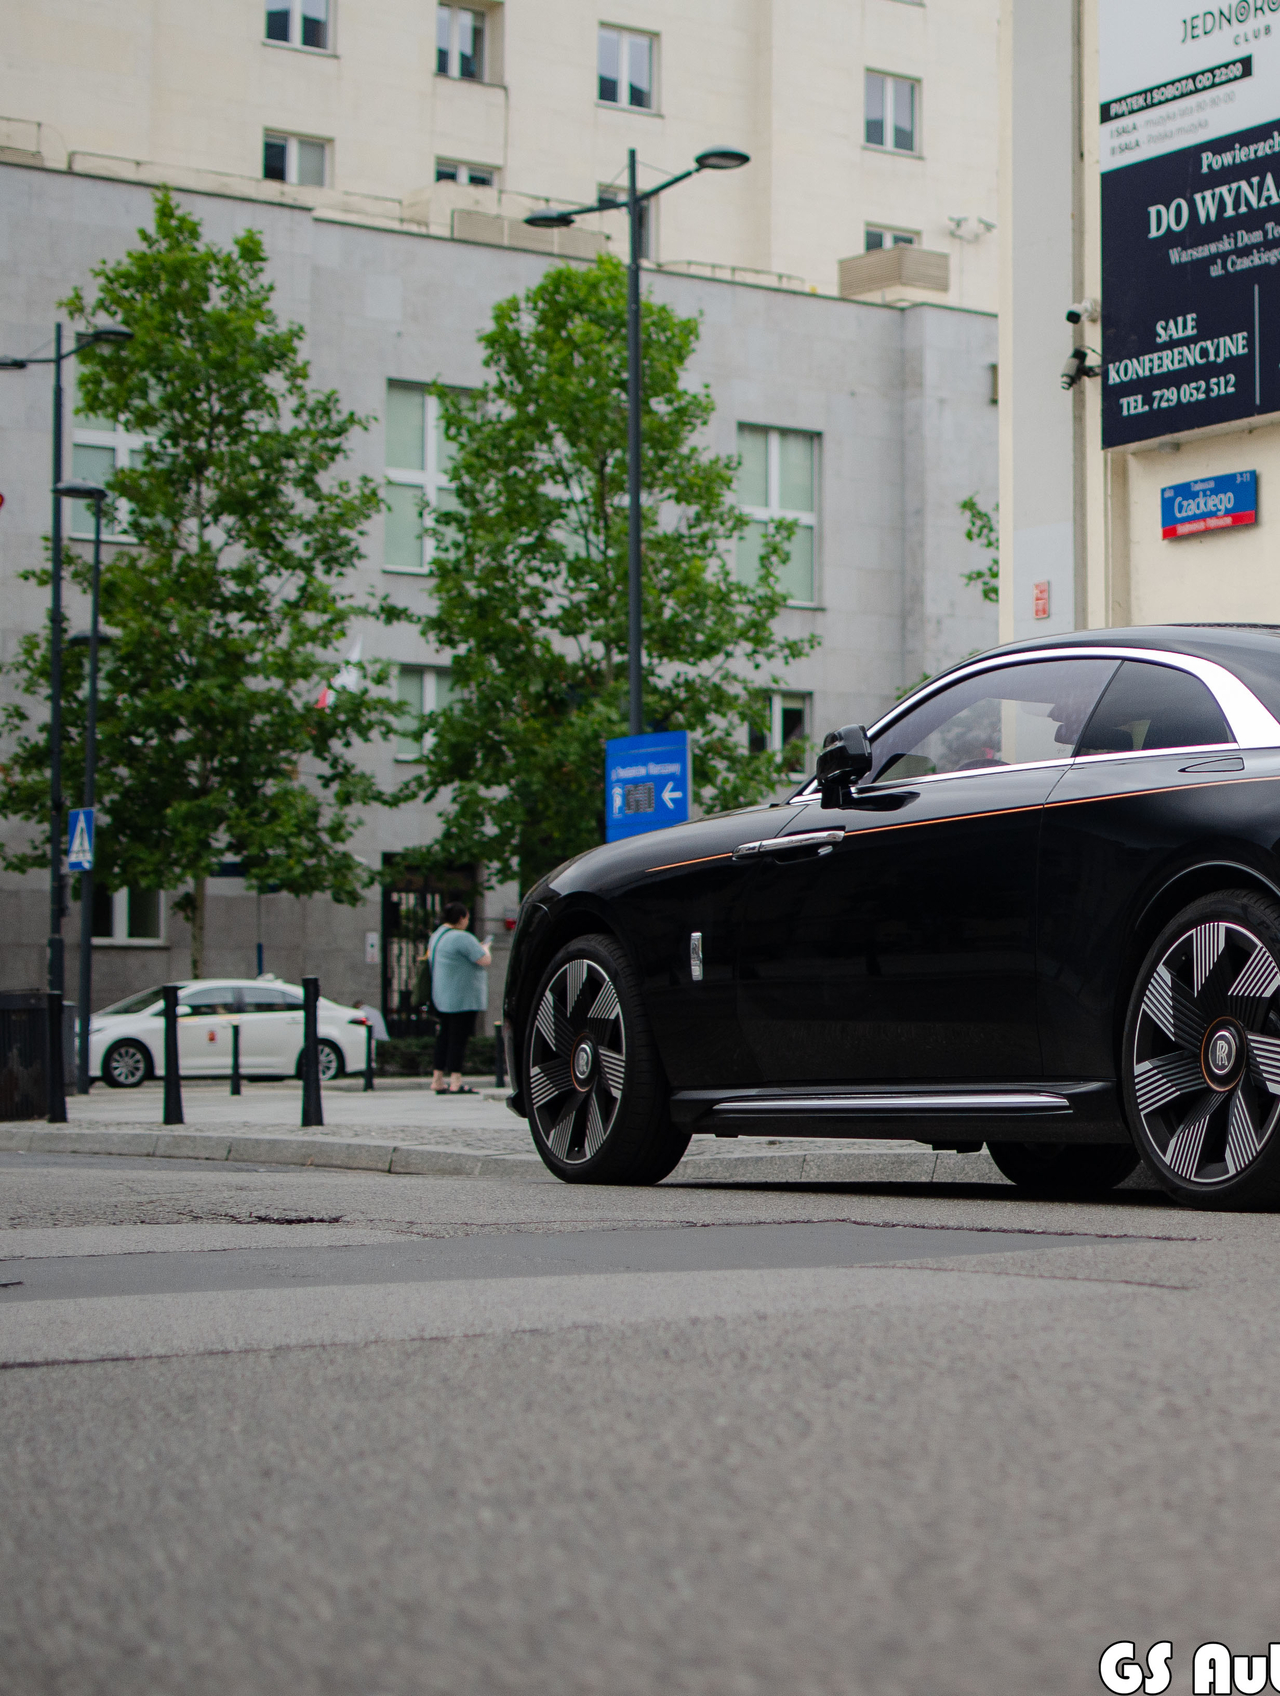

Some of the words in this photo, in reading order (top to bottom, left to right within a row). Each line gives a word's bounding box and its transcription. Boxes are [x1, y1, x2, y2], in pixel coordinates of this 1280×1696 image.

[1233, 24, 1272, 46] CLUB
[1110, 92, 1146, 117] PIĄTEK
[1151, 78, 1195, 104] SOBOTA
[1195, 72, 1213, 90] OD
[1213, 62, 1243, 84] 22:00
[1115, 122, 1138, 138] SALA
[1117, 138, 1140, 154] SALA
[1147, 197, 1188, 239] DO
[1169, 233, 1235, 266] Warszawski
[1237, 228, 1263, 247] Dom
[1210, 259, 1225, 278] ul.
[1155, 312, 1198, 344] SALE
[1107, 331, 1249, 385] KONFERENCYJNE
[1120, 394, 1149, 417] TEL.
[1152, 386, 1178, 410] 729
[1180, 380, 1206, 404] 052
[1209, 373, 1236, 397] 512
[1174, 491, 1234, 518] Czackiego
